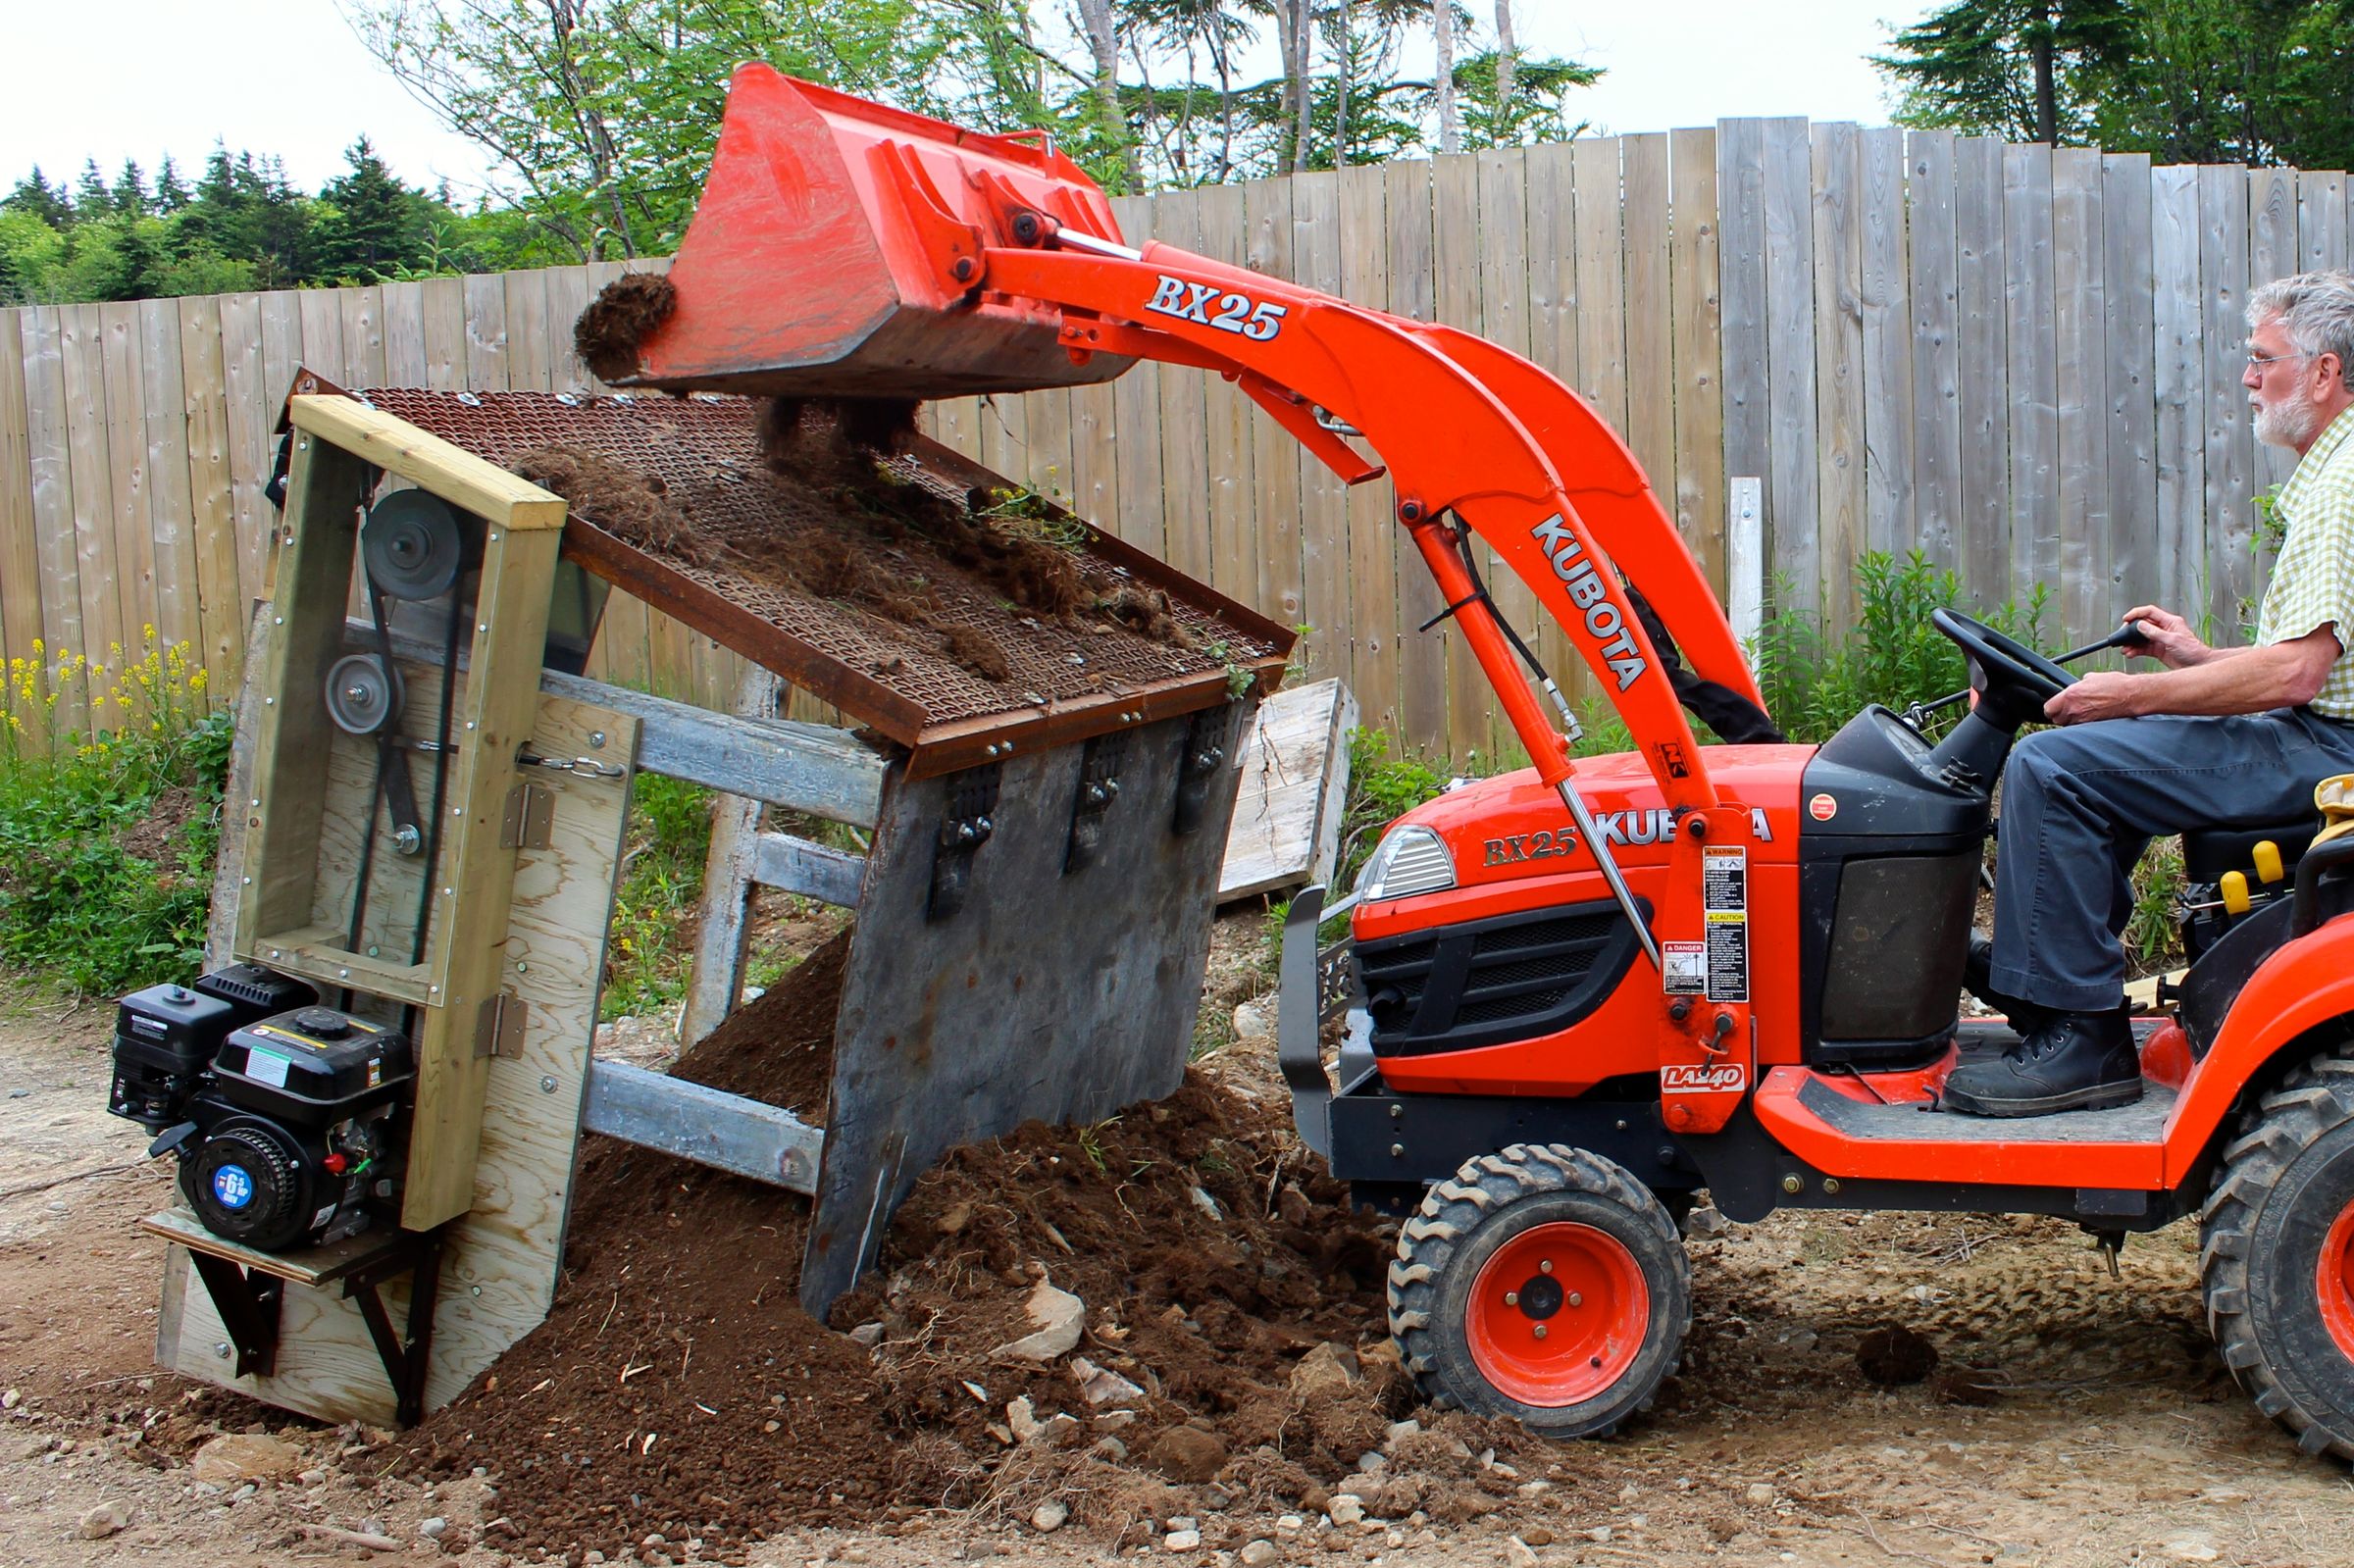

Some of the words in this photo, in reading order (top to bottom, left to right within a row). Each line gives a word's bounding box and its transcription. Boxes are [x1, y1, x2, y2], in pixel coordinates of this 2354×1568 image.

[1145, 274, 1288, 342] BX25
[1530, 511, 1649, 692] KUBOTA
[1594, 808, 1774, 846] KUBA
[1483, 828, 1578, 867] BX25
[1665, 1066, 1741, 1088] LA240
